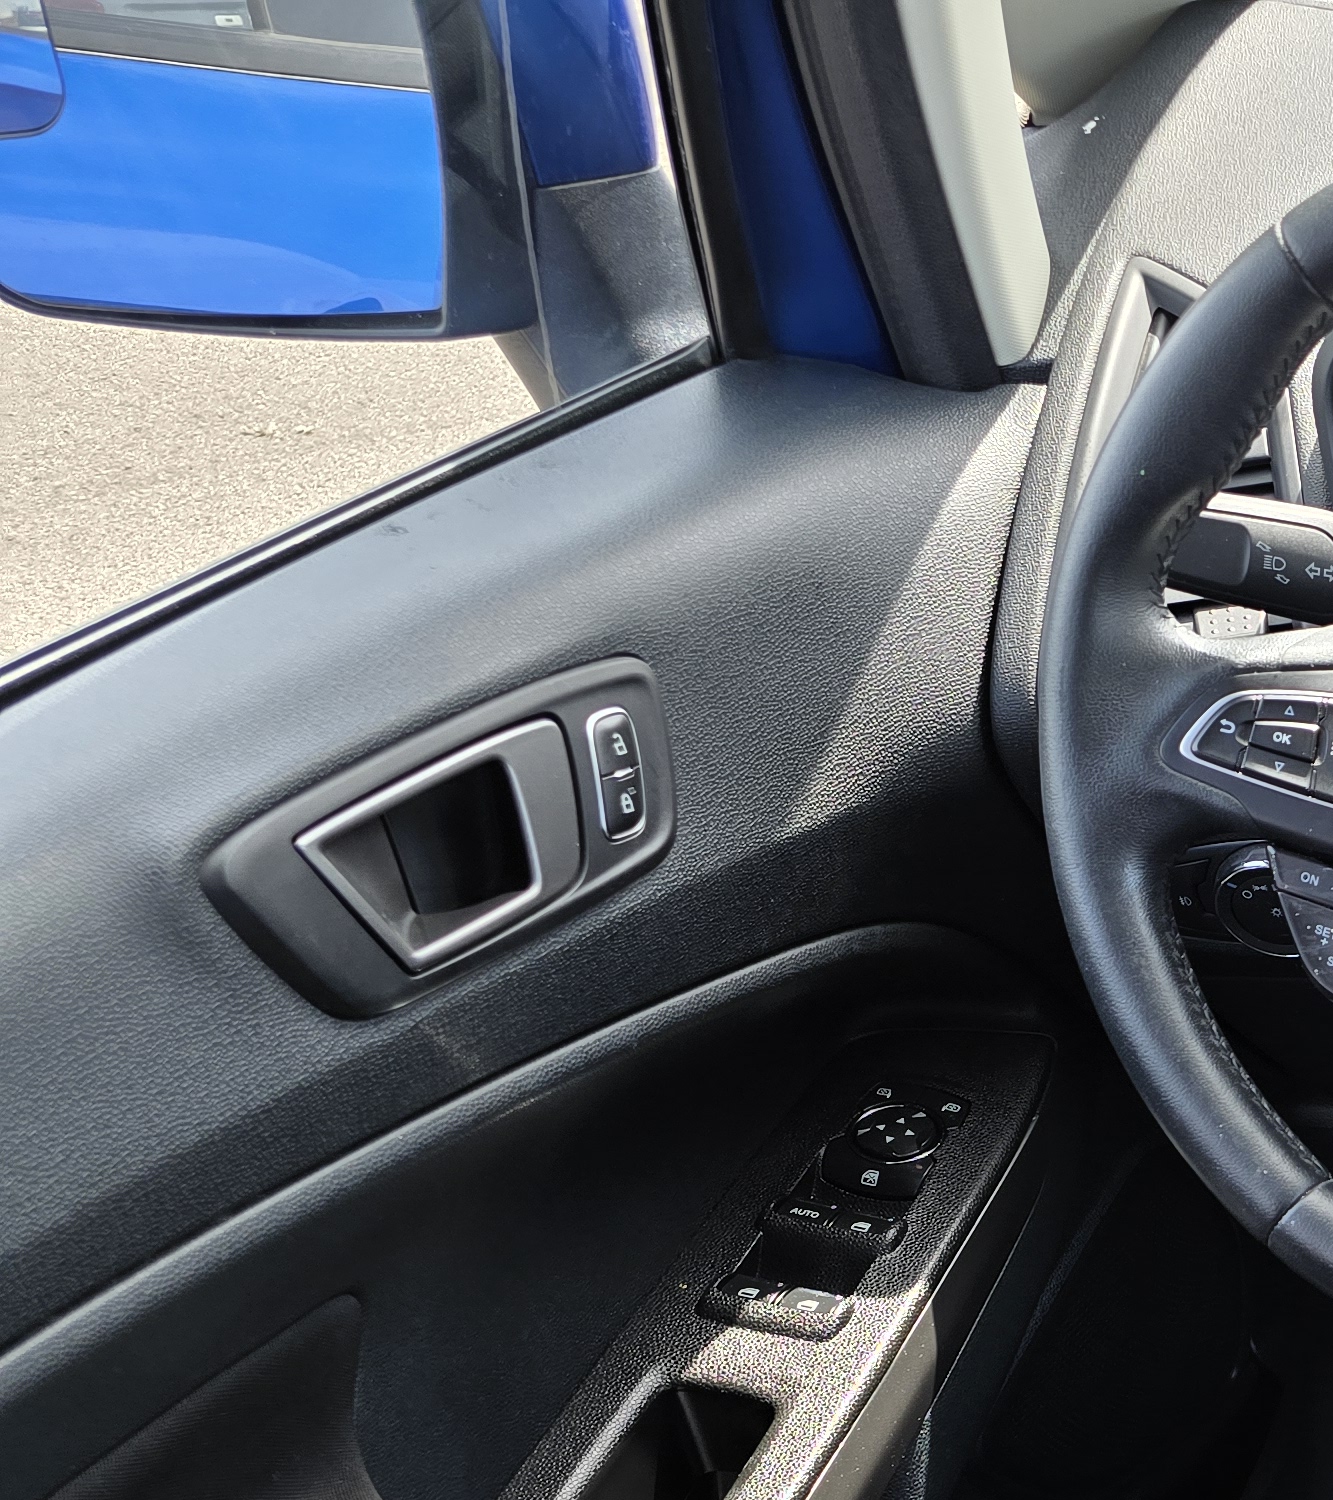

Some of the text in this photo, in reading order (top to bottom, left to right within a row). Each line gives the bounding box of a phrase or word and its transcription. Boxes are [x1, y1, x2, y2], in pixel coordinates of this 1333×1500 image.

[1273, 732, 1291, 745] OK
[1300, 871, 1320, 886] ON
[789, 1207, 820, 1219] AUTO
